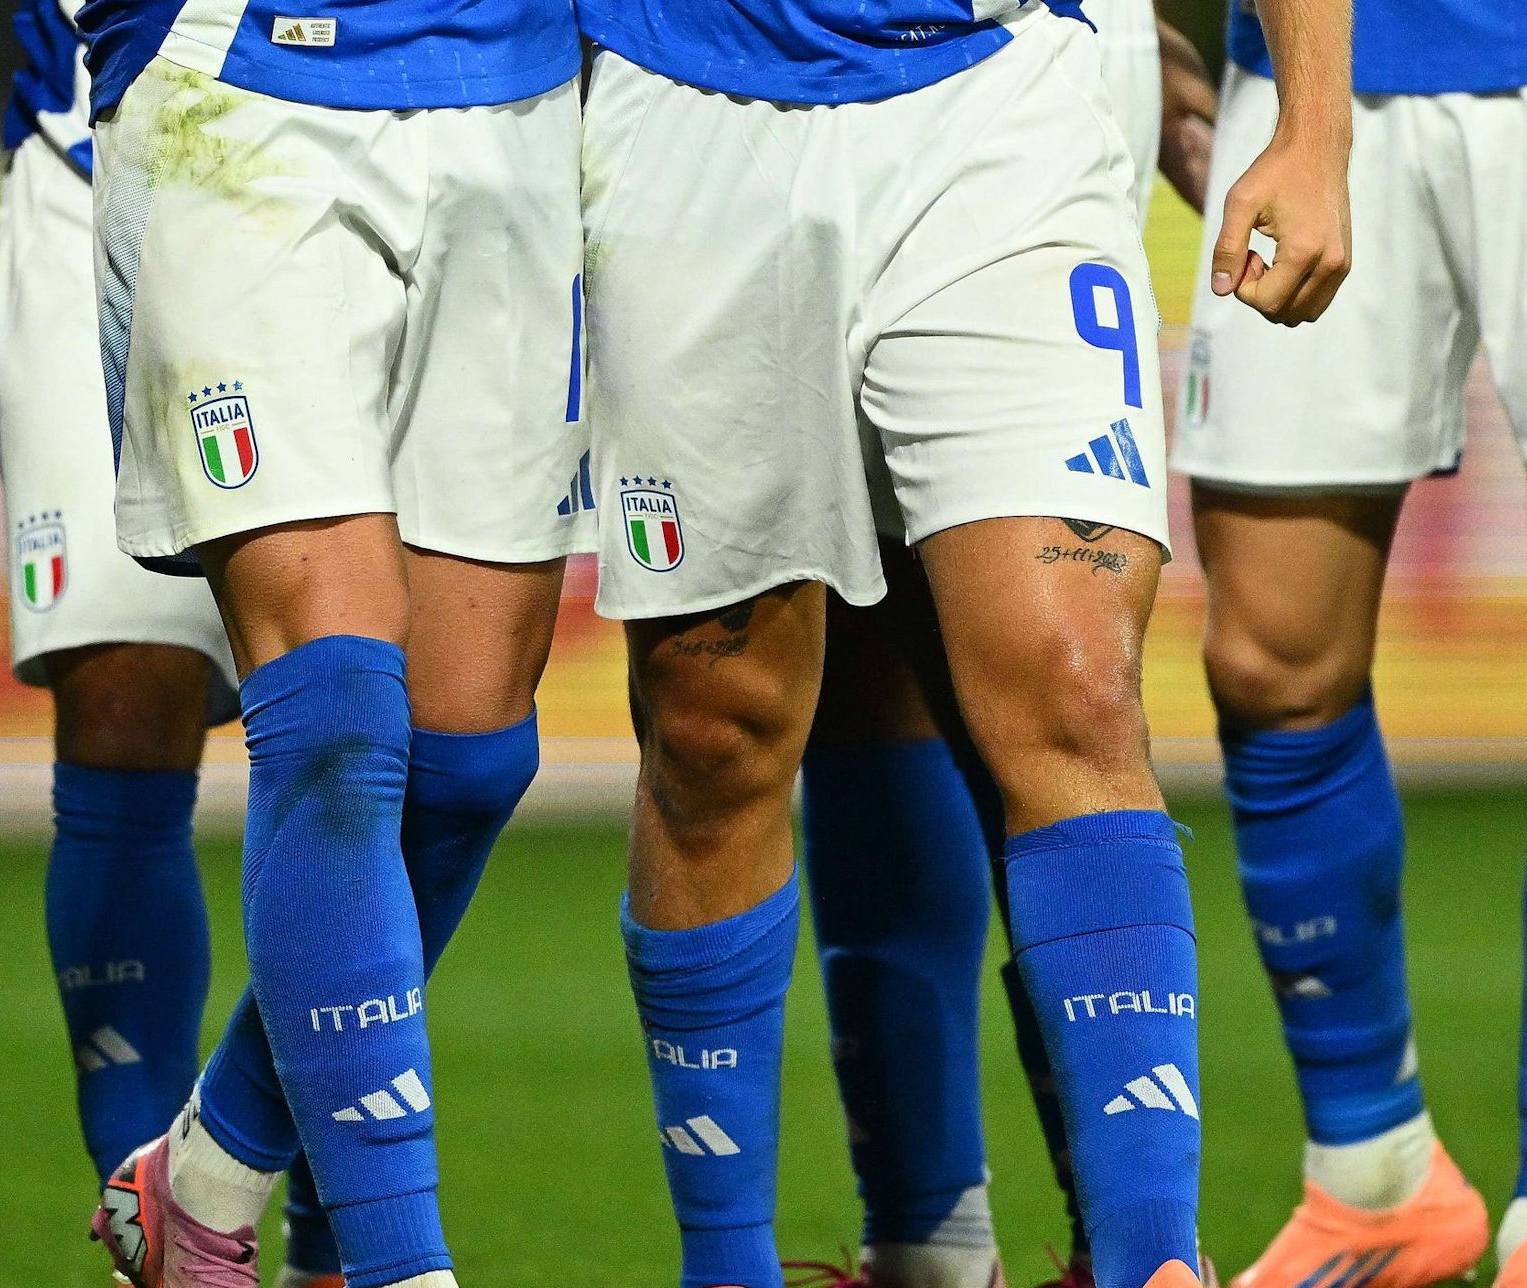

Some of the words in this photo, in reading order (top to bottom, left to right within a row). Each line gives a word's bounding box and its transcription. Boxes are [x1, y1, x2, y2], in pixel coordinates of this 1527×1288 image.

[1068, 262, 1143, 409] 9
[196, 403, 244, 429] ITALIA
[626, 497, 672, 513] ITALIA
[311, 987, 422, 1032] ITALIA
[1063, 990, 1195, 1022] ITALIA
[651, 1038, 738, 1070] ALIA
